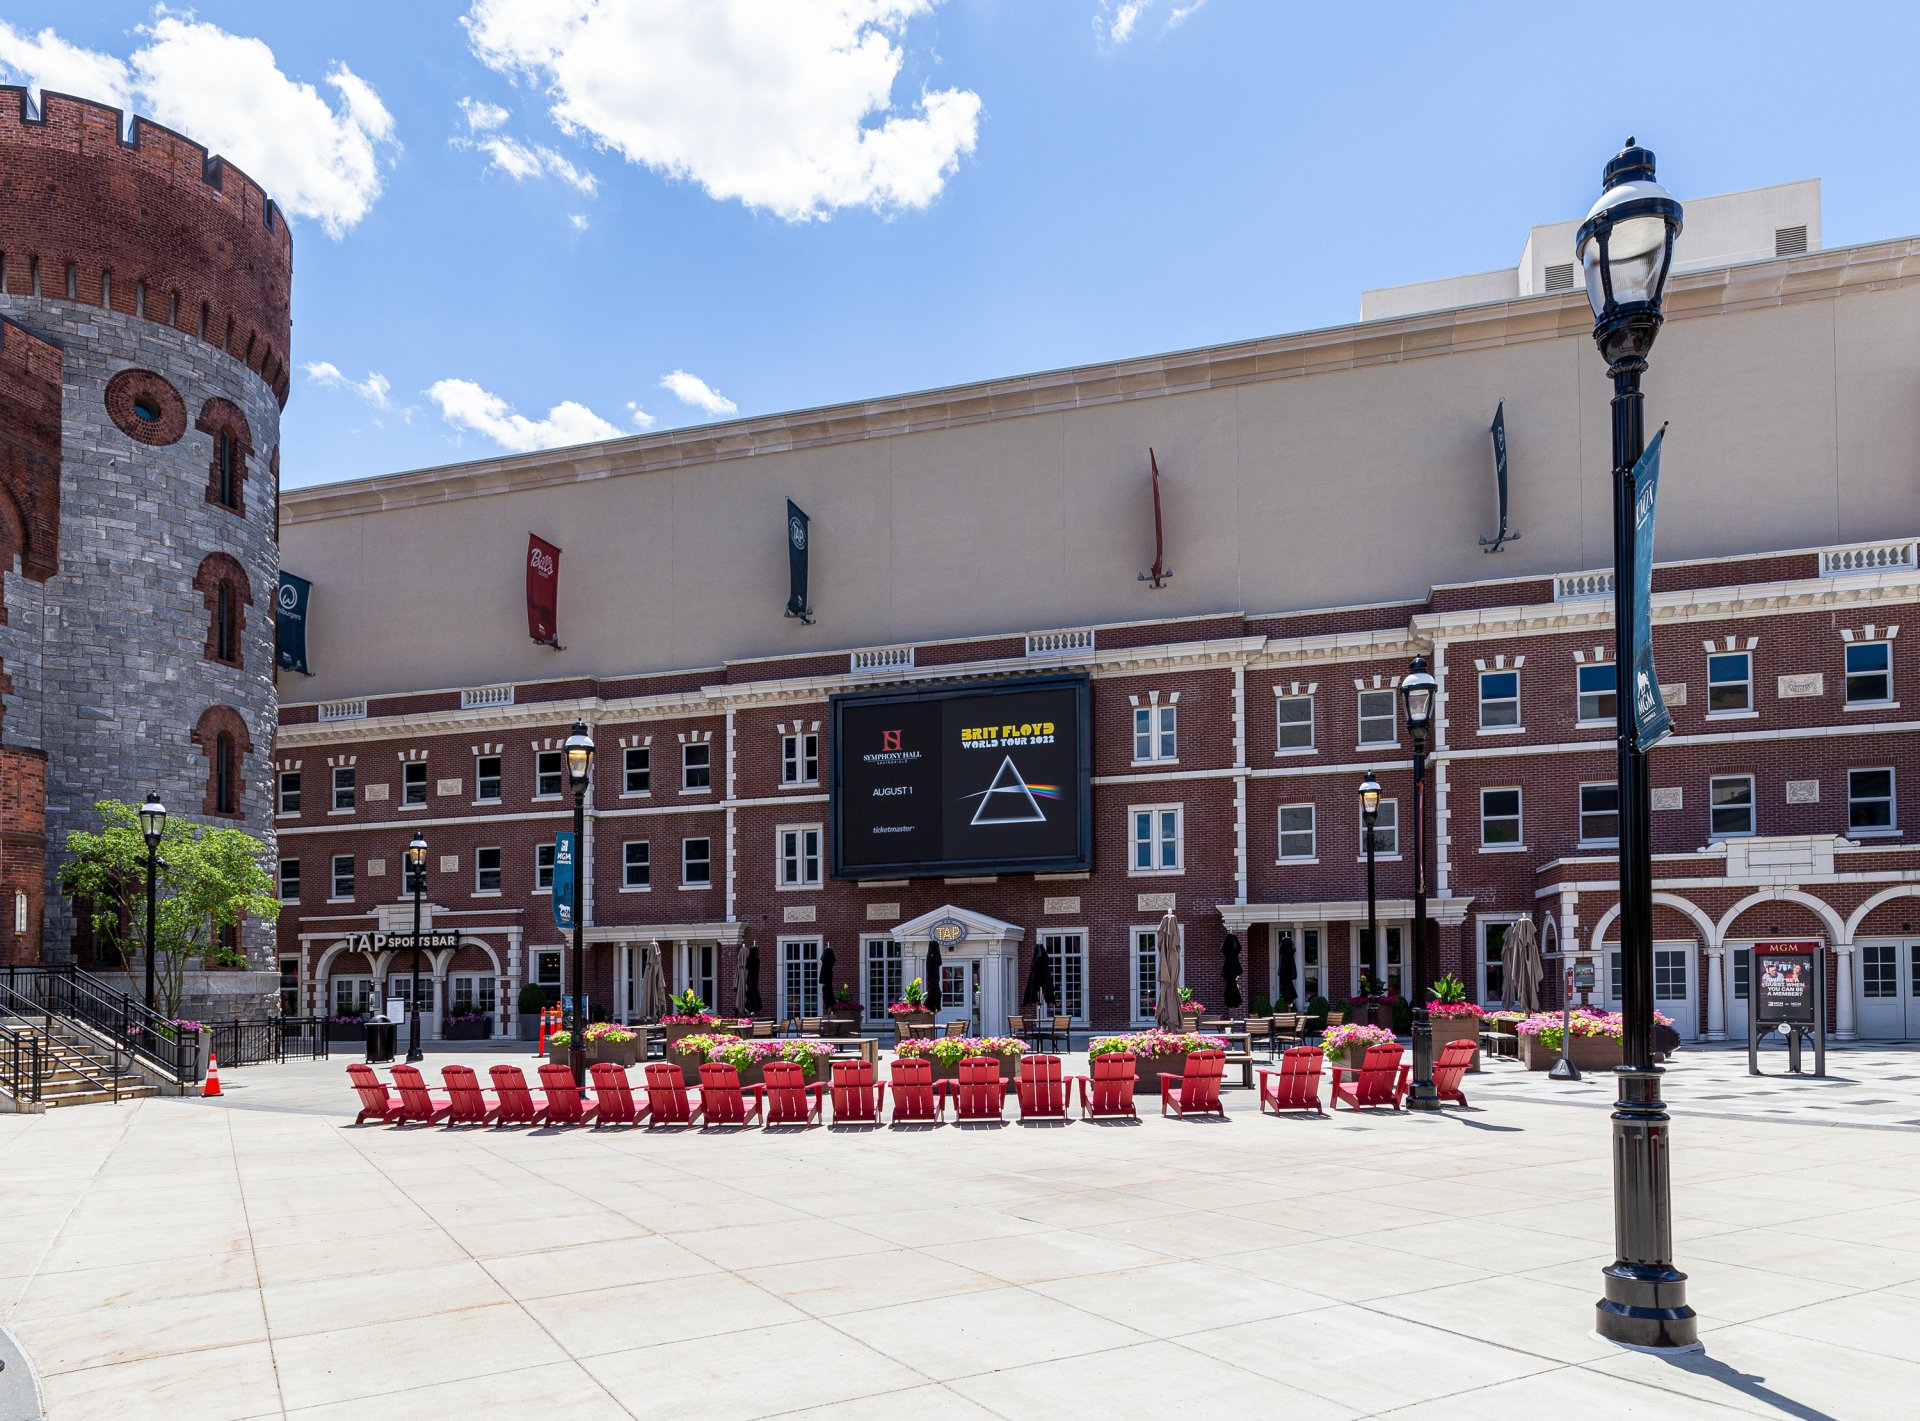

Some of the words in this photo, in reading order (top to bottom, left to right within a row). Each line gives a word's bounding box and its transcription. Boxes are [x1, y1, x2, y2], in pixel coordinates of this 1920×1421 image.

[1637, 689, 1655, 716] MGM
[961, 726, 999, 741] BRIT
[1002, 722, 1055, 738] FLOYD
[962, 740, 999, 749] WORLD
[1000, 737, 1028, 747] TOUR
[1029, 735, 1055, 744] 2022
[863, 752, 902, 761] SYMPHONY
[872, 786, 908, 797] AUGUST
[557, 852, 572, 860] MGM
[936, 926, 960, 940] TAP
[345, 934, 386, 953] TAP
[432, 935, 456, 946] BAR
[1769, 943, 1799, 952] MGM
